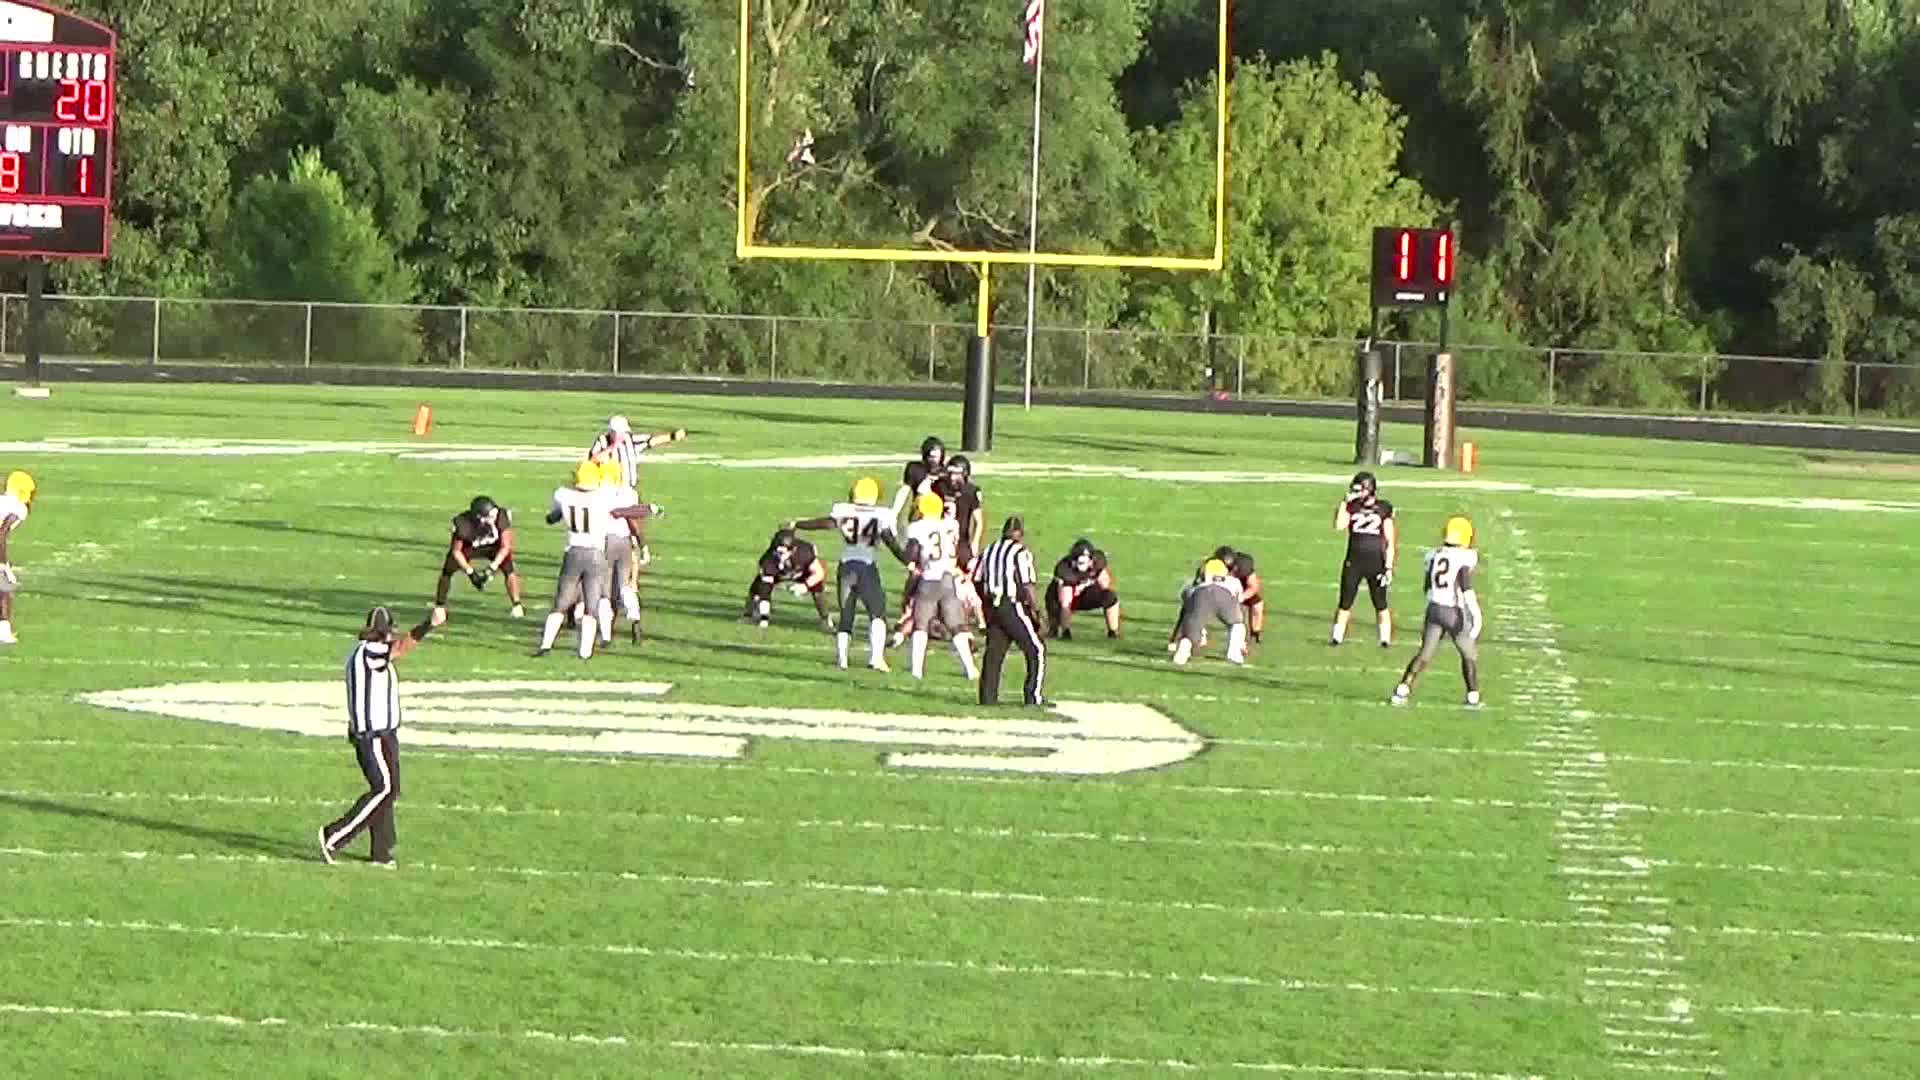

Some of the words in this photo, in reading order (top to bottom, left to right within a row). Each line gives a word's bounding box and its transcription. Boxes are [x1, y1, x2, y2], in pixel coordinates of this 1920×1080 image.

[19, 51, 106, 80] GUESTS
[57, 80, 106, 121] 20
[80, 158, 87, 193] 1
[1400, 232, 1448, 281] 11
[568, 506, 590, 533] 11
[841, 517, 878, 546] 34
[1351, 513, 1381, 535] 22
